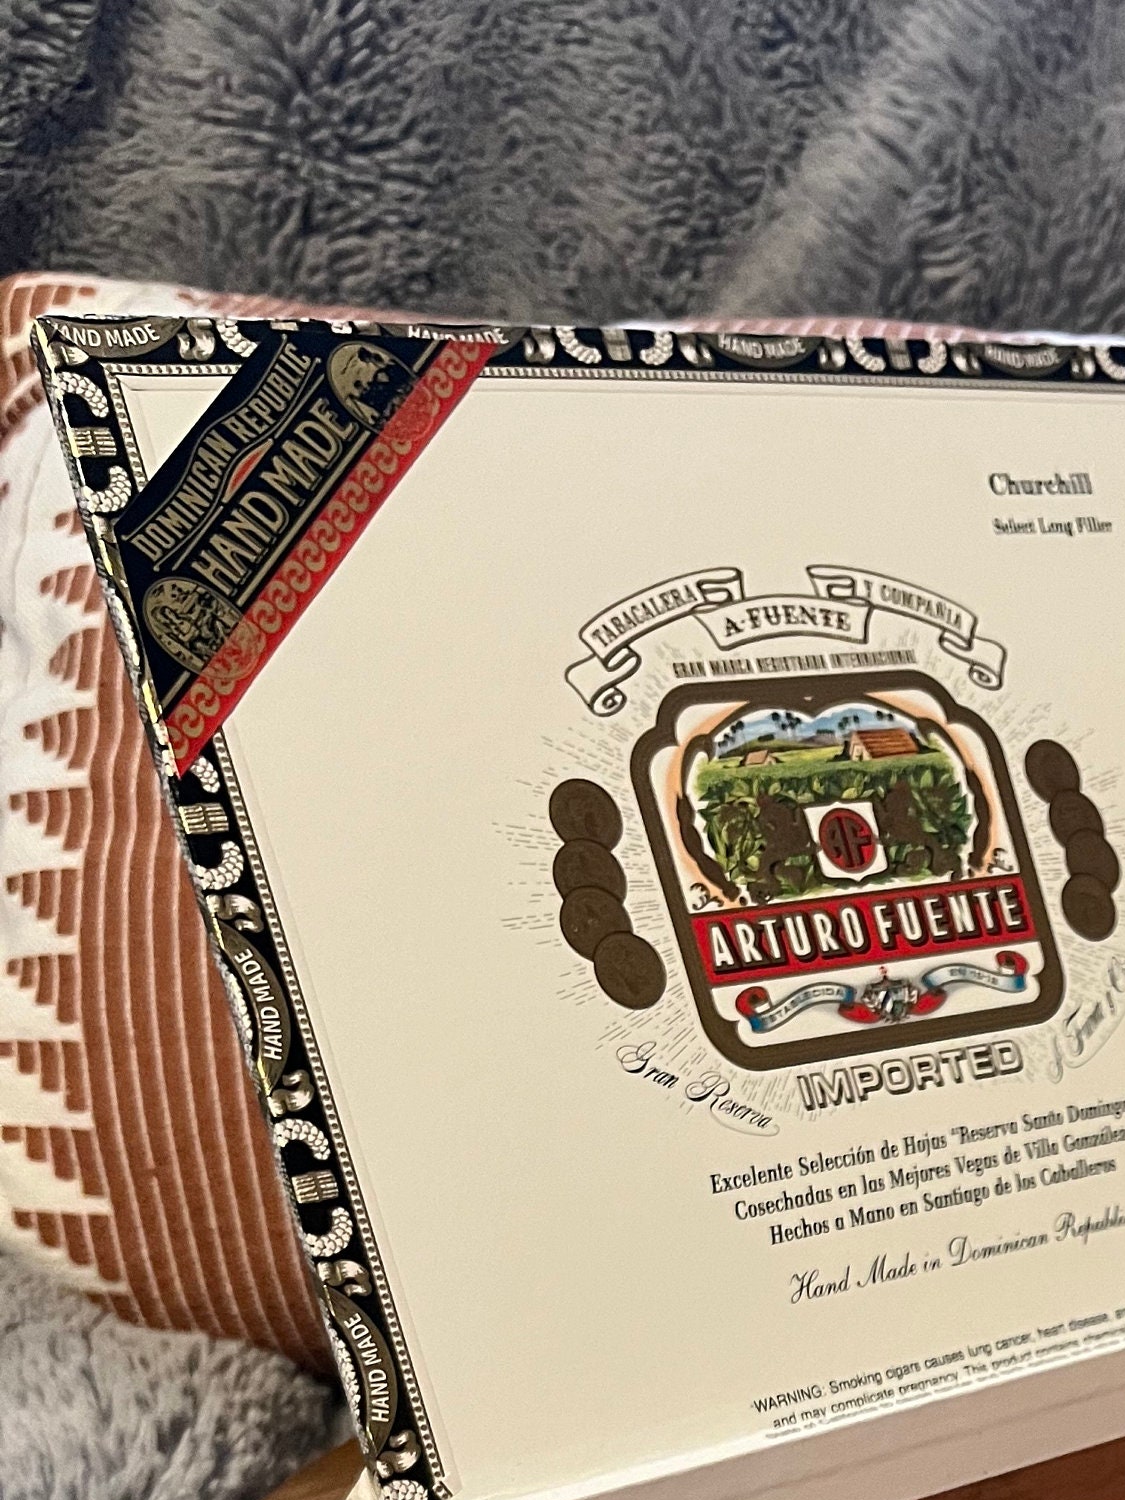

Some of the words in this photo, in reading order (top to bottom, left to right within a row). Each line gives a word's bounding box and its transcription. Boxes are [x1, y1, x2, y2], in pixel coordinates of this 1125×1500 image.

[58, 327, 101, 348] AND
[104, 324, 160, 348] MADE
[130, 429, 236, 562] DOMINICAN
[221, 342, 313, 444] REPUBLIC
[988, 472, 1093, 496] Churchill
[191, 490, 289, 597] HAND
[259, 397, 359, 506] MADE
[1037, 517, 1074, 537] Long
[590, 584, 699, 647] TABACALERA
[709, 903, 869, 972] ARTURO
[871, 886, 1028, 948] FUENTE
[234, 948, 276, 1004] MADE
[260, 1006, 283, 1061] HAND
[615, 1040, 681, 1090] Gran
[684, 1070, 781, 1138] Reserva
[796, 1039, 1024, 1112] IMPORTED
[709, 1162, 794, 1195] Excelente
[798, 1145, 876, 1177] Selección
[880, 1139, 900, 1161] de
[902, 1132, 948, 1157] Hojas
[1021, 1111, 1064, 1132] Santo
[734, 1185, 834, 1221] Cosechadas
[838, 1182, 858, 1200] en
[861, 1173, 886, 1196] las
[888, 1162, 951, 1191] Mejores
[954, 1153, 1000, 1178] Vegas
[1003, 1145, 1021, 1166] de
[1024, 1137, 1060, 1160] Villa
[769, 1217, 830, 1246] Hechos
[834, 1216, 846, 1231] a
[848, 1205, 896, 1229] Mano
[899, 1199, 919, 1217] en
[922, 1184, 990, 1213] Santiago
[994, 1177, 1013, 1197] de
[1015, 1172, 1037, 1193] los
[1039, 1158, 1117, 1187] Caballeros
[789, 1265, 852, 1305] Hand
[856, 1250, 919, 1288] Made
[923, 1252, 943, 1272] in
[948, 1228, 1049, 1268] Dominican
[343, 1312, 382, 1367] MADE
[752, 1384, 827, 1414] WARNING:
[828, 1370, 884, 1395] Smoking
[885, 1360, 922, 1382] cigars
[923, 1349, 965, 1369] causes
[967, 1343, 993, 1357] lung
[1036, 1323, 1066, 1339] heart
[368, 1368, 390, 1423] HAND
[772, 1412, 798, 1429] and
[800, 1406, 828, 1421] may
[830, 1387, 896, 1415] complicate
